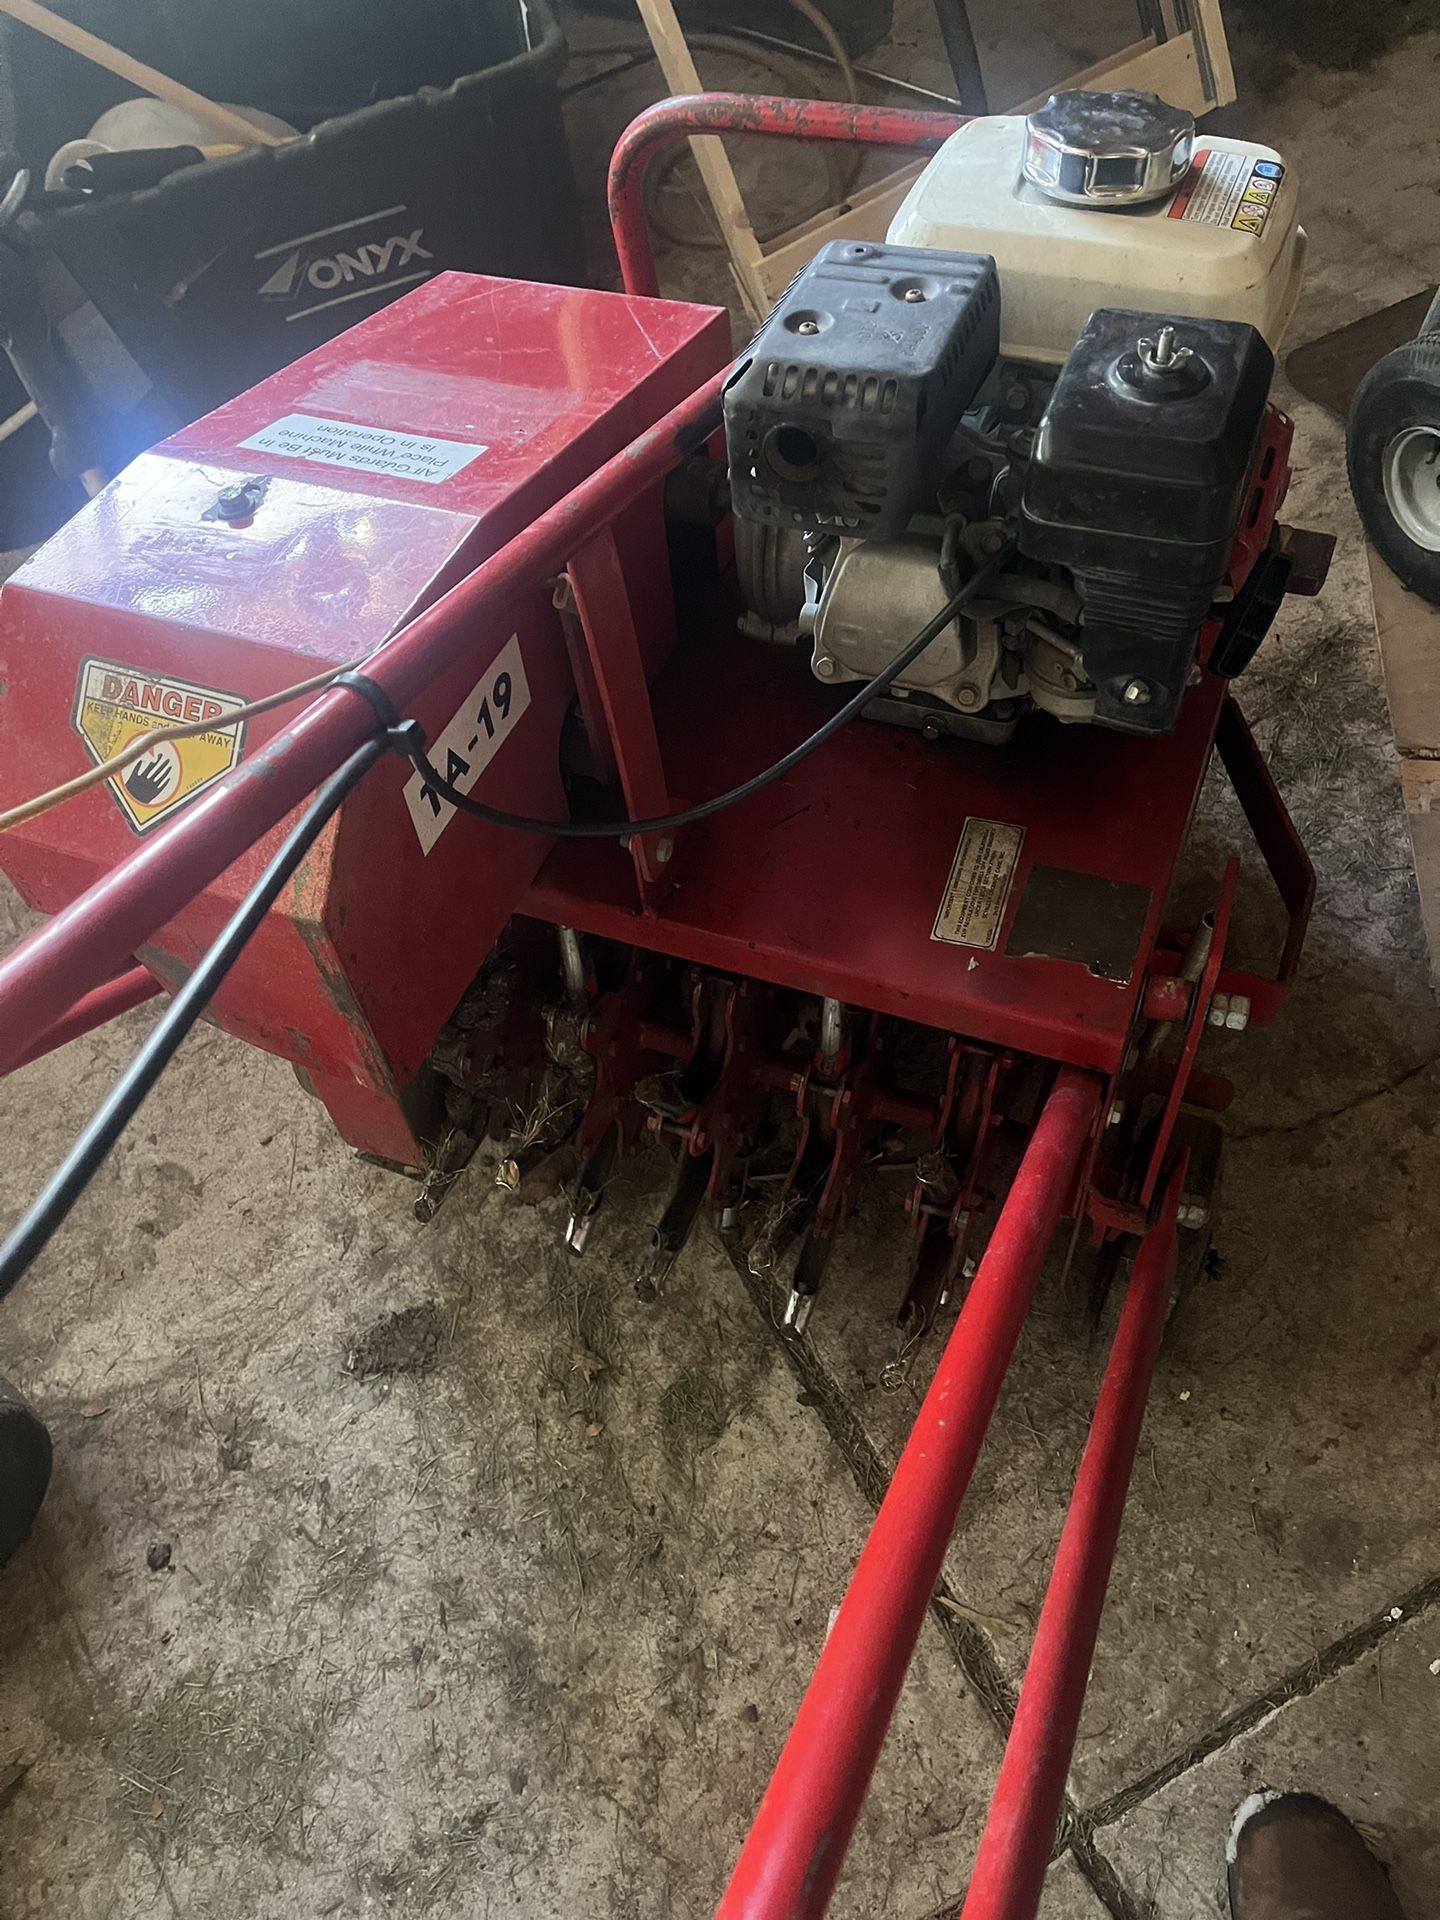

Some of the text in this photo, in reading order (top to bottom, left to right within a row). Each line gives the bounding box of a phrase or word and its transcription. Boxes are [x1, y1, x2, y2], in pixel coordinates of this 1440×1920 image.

[307, 229, 434, 289] ONYX
[258, 437, 439, 477] All Guards Must Be In
[278, 429, 450, 468] Place While Machine
[316, 424, 437, 452] Is In Operation
[101, 674, 222, 722] DANGER
[87, 701, 115, 715] KEEP
[115, 706, 149, 726] HANDS
[199, 731, 231, 749] AWAY
